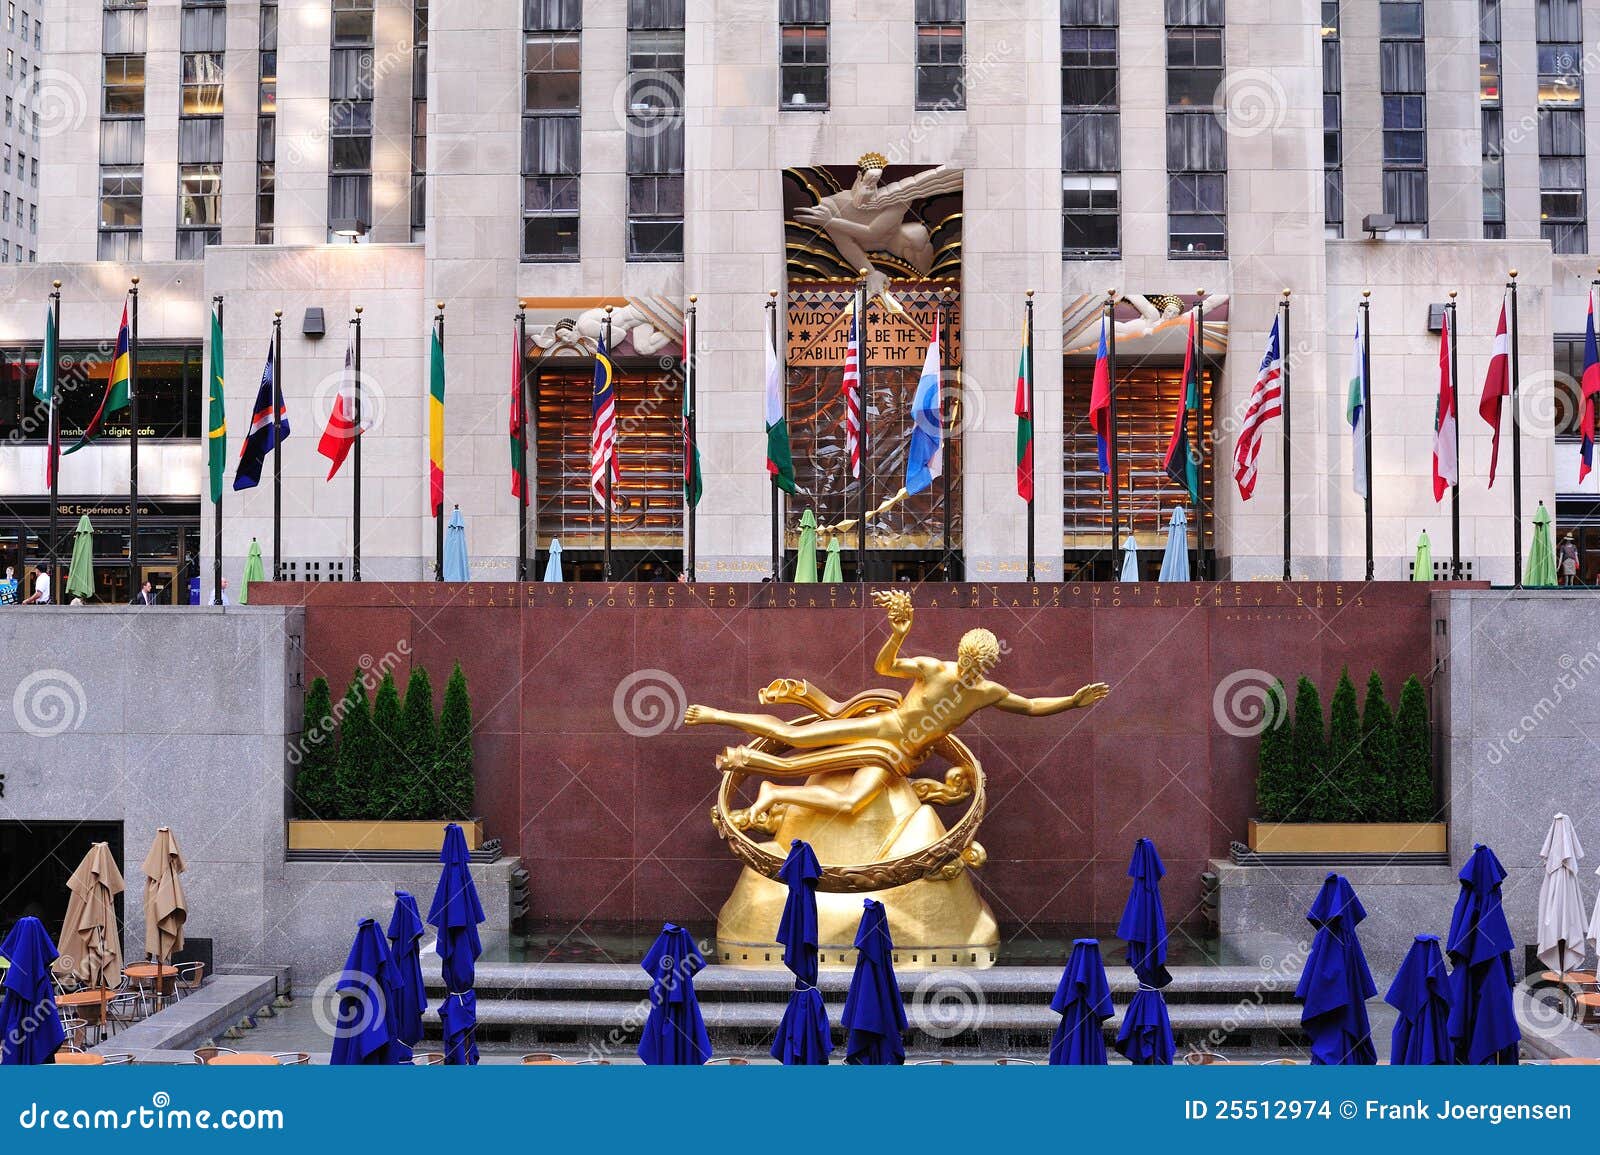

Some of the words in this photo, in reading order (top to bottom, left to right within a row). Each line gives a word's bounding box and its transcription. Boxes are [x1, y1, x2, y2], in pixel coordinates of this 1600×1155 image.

[789, 312, 837, 325] WISDO
[882, 312, 959, 325] KNWLEDE
[875, 330, 890, 342] BE
[895, 330, 915, 342] THE
[789, 347, 848, 360] STABILIT
[865, 347, 879, 360] OF
[883, 347, 910, 360] THY
[109, 427, 132, 437] digita
[137, 426, 155, 435] cafe
[57, 506, 74, 514] NBC
[76, 506, 123, 516] Experience
[125, 506, 149, 514] Sre
[608, 586, 736, 595] TEACHER
[771, 586, 796, 595] IN
[951, 587, 998, 595] ART
[1033, 586, 1161, 595] BROUGHT
[1194, 586, 1241, 594] THE
[1276, 585, 1343, 594] FIRE
[468, 598, 535, 607] HATH
[568, 598, 675, 607] PROVED
[708, 598, 736, 607] TO
[769, 598, 879, 607] MORTAL
[931, 598, 938, 607] A
[971, 598, 1060, 607] MEANS
[1094, 598, 1121, 606] TO
[1153, 598, 1262, 606] MIGHTY
[1297, 598, 1365, 606] ENDS
